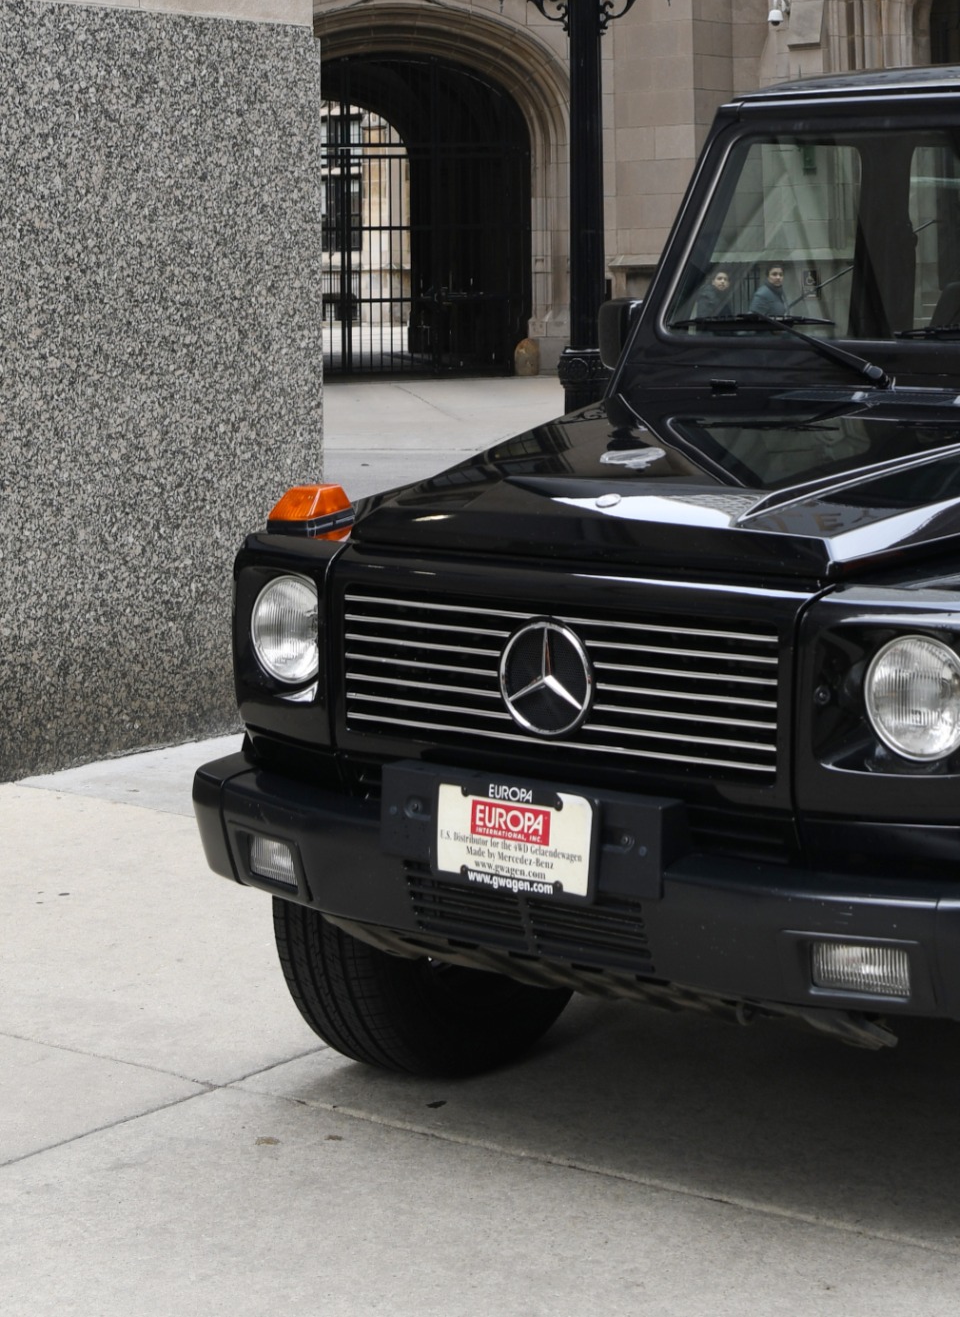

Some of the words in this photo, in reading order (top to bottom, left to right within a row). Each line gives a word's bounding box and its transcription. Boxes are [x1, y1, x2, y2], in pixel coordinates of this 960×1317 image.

[488, 784, 533, 803] EUROPA
[475, 804, 543, 835] EUROPA
[476, 826, 527, 841] INTERNATIONAL,
[529, 834, 543, 843] INC.
[440, 829, 452, 840] U.S.
[453, 831, 488, 845] Distributor
[490, 837, 499, 848] for
[501, 840, 512, 851] the
[530, 844, 583, 863] Gelaendewagen
[466, 845, 485, 858] Made
[487, 848, 496, 861] by
[474, 860, 546, 881] www.gwagen.com
[467, 870, 553, 896] www.gwagen.com
